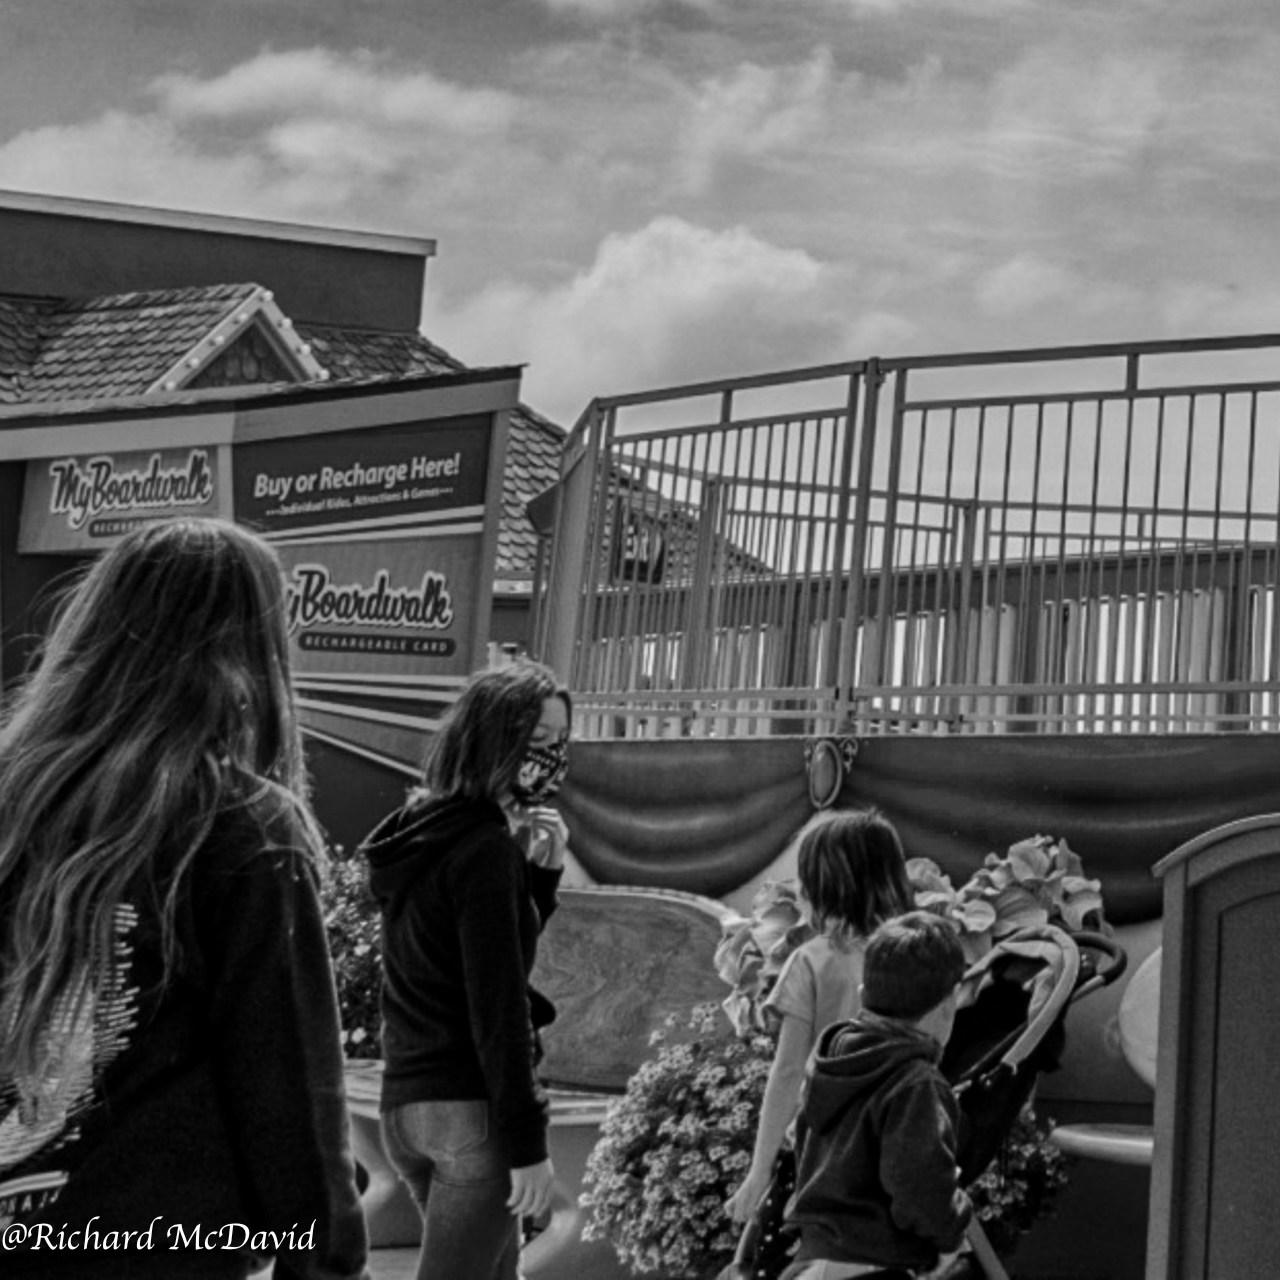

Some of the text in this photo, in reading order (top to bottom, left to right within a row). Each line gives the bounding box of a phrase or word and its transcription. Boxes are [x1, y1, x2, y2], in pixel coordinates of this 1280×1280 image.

[254, 451, 462, 502] Buy or Recharge Here!
[412, 639, 448, 652] CARD
